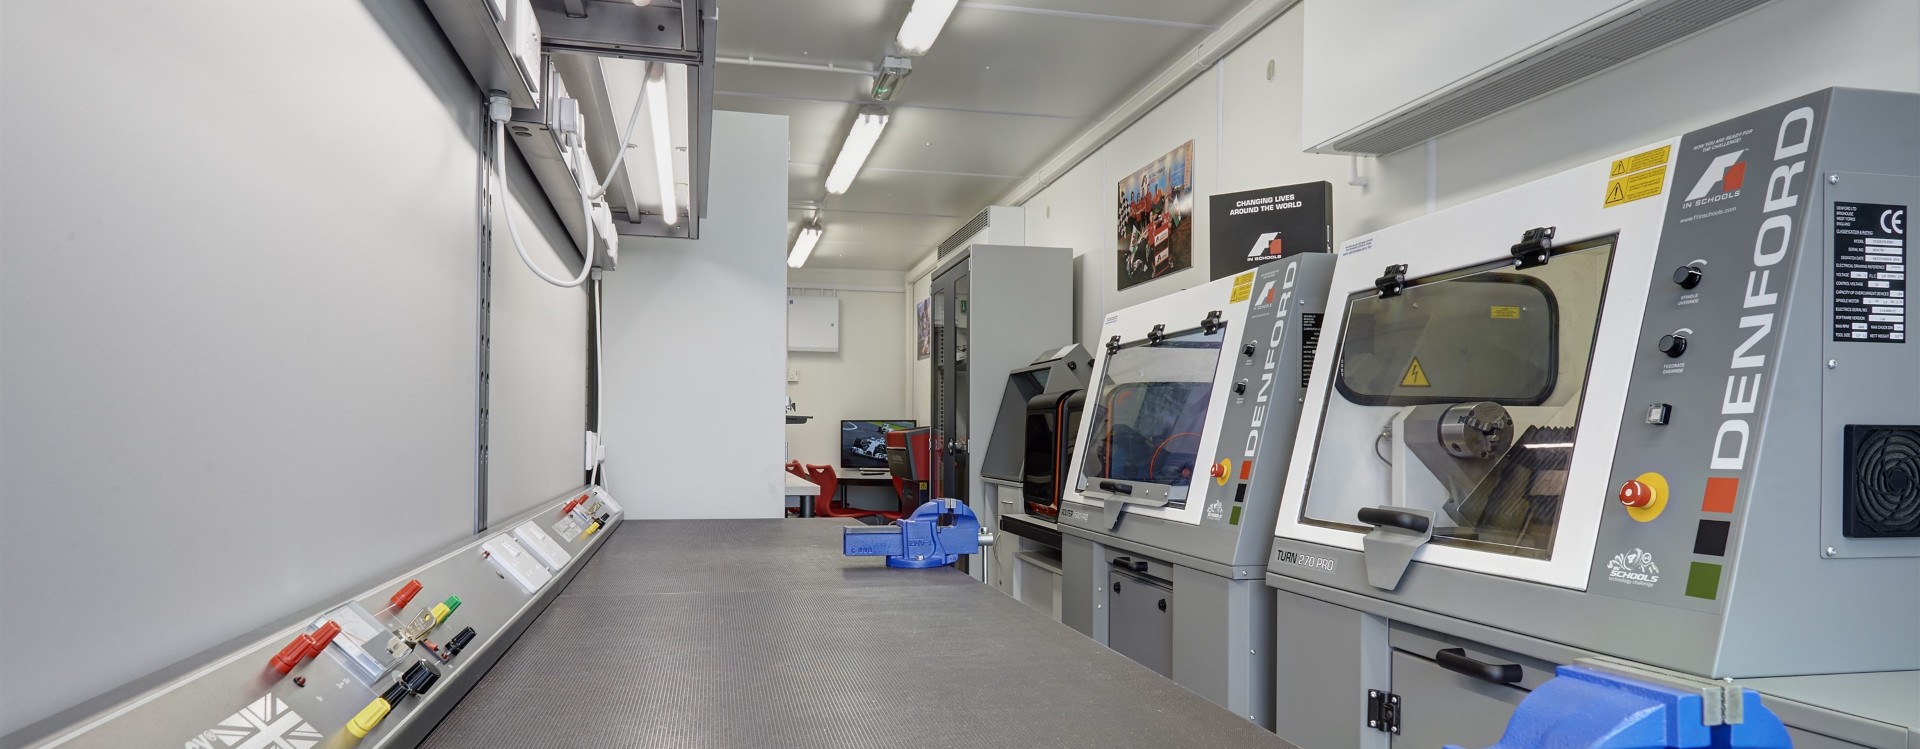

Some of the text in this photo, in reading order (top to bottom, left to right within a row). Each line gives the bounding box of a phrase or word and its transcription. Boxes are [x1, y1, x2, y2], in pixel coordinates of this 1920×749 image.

[1726, 132, 1742, 141] READY
[1229, 201, 1302, 216] AROUND THE WORLD
[1236, 194, 1295, 207] CHANGING LIVES
[1683, 190, 1740, 210] IN SCHOOLS
[1680, 206, 1737, 223] www.f1inschools.com
[1880, 209, 1904, 234] CE
[1710, 106, 1815, 470] DENFORD
[1244, 261, 1297, 457] DENFORD
[1277, 549, 1334, 571] TURN 270 PRO
[1609, 570, 1660, 583] SCHOOLS
